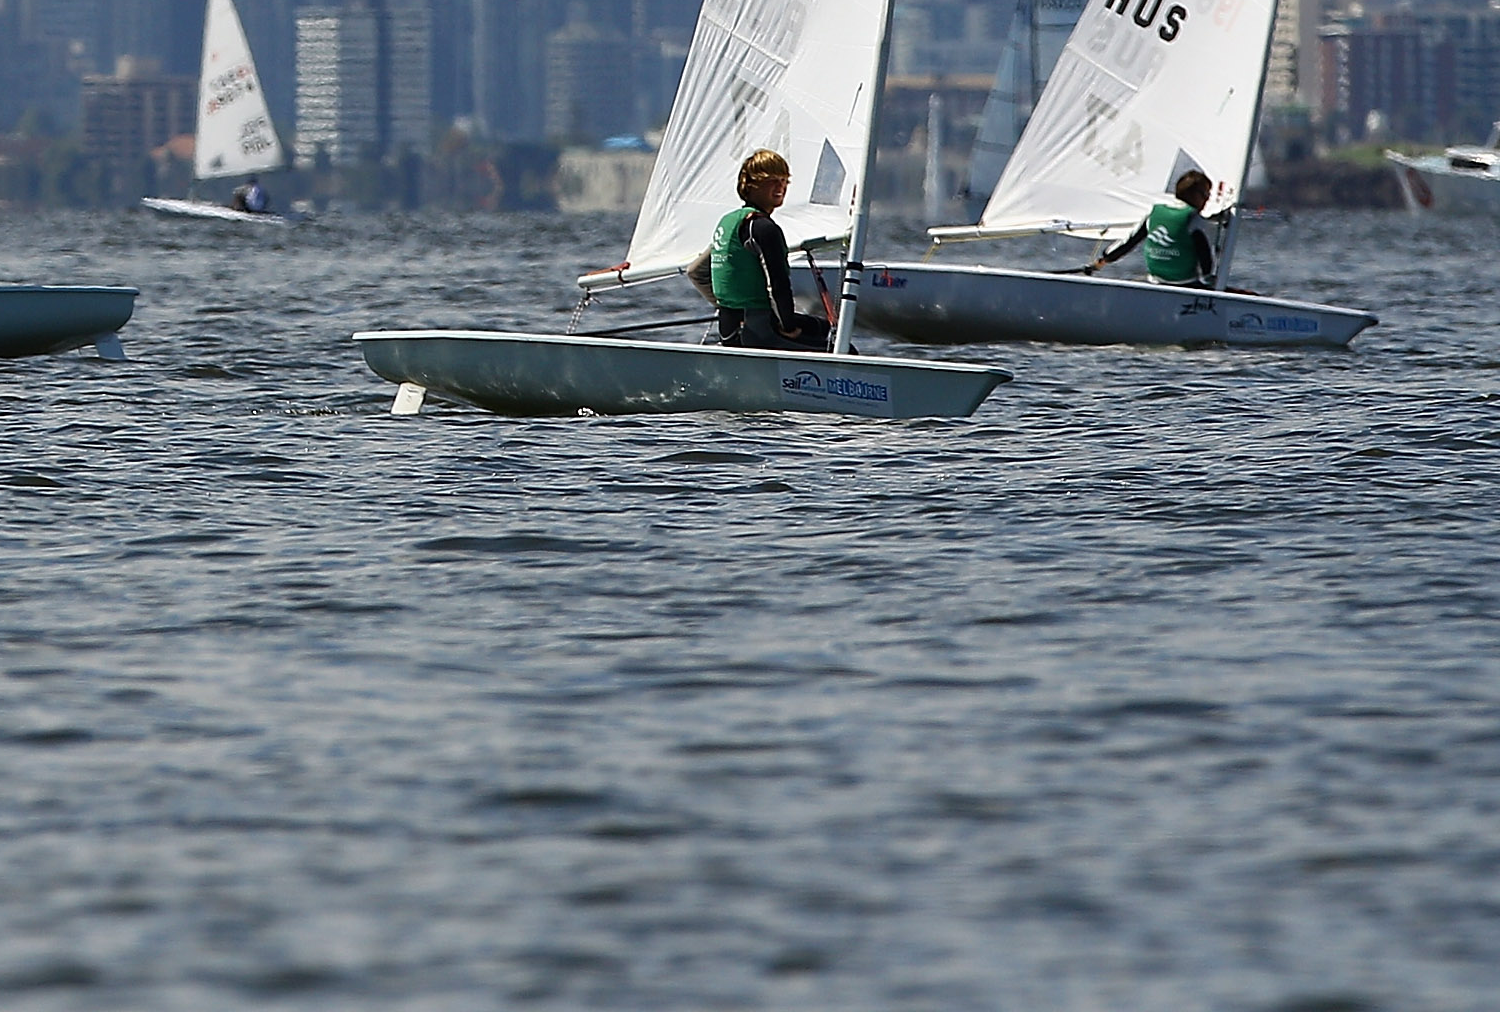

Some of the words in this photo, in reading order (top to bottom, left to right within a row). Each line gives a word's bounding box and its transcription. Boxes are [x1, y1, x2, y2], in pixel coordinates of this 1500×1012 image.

[872, 273, 908, 288] Laer
[782, 376, 801, 390] sail
[827, 377, 888, 402] MELBOURNE
